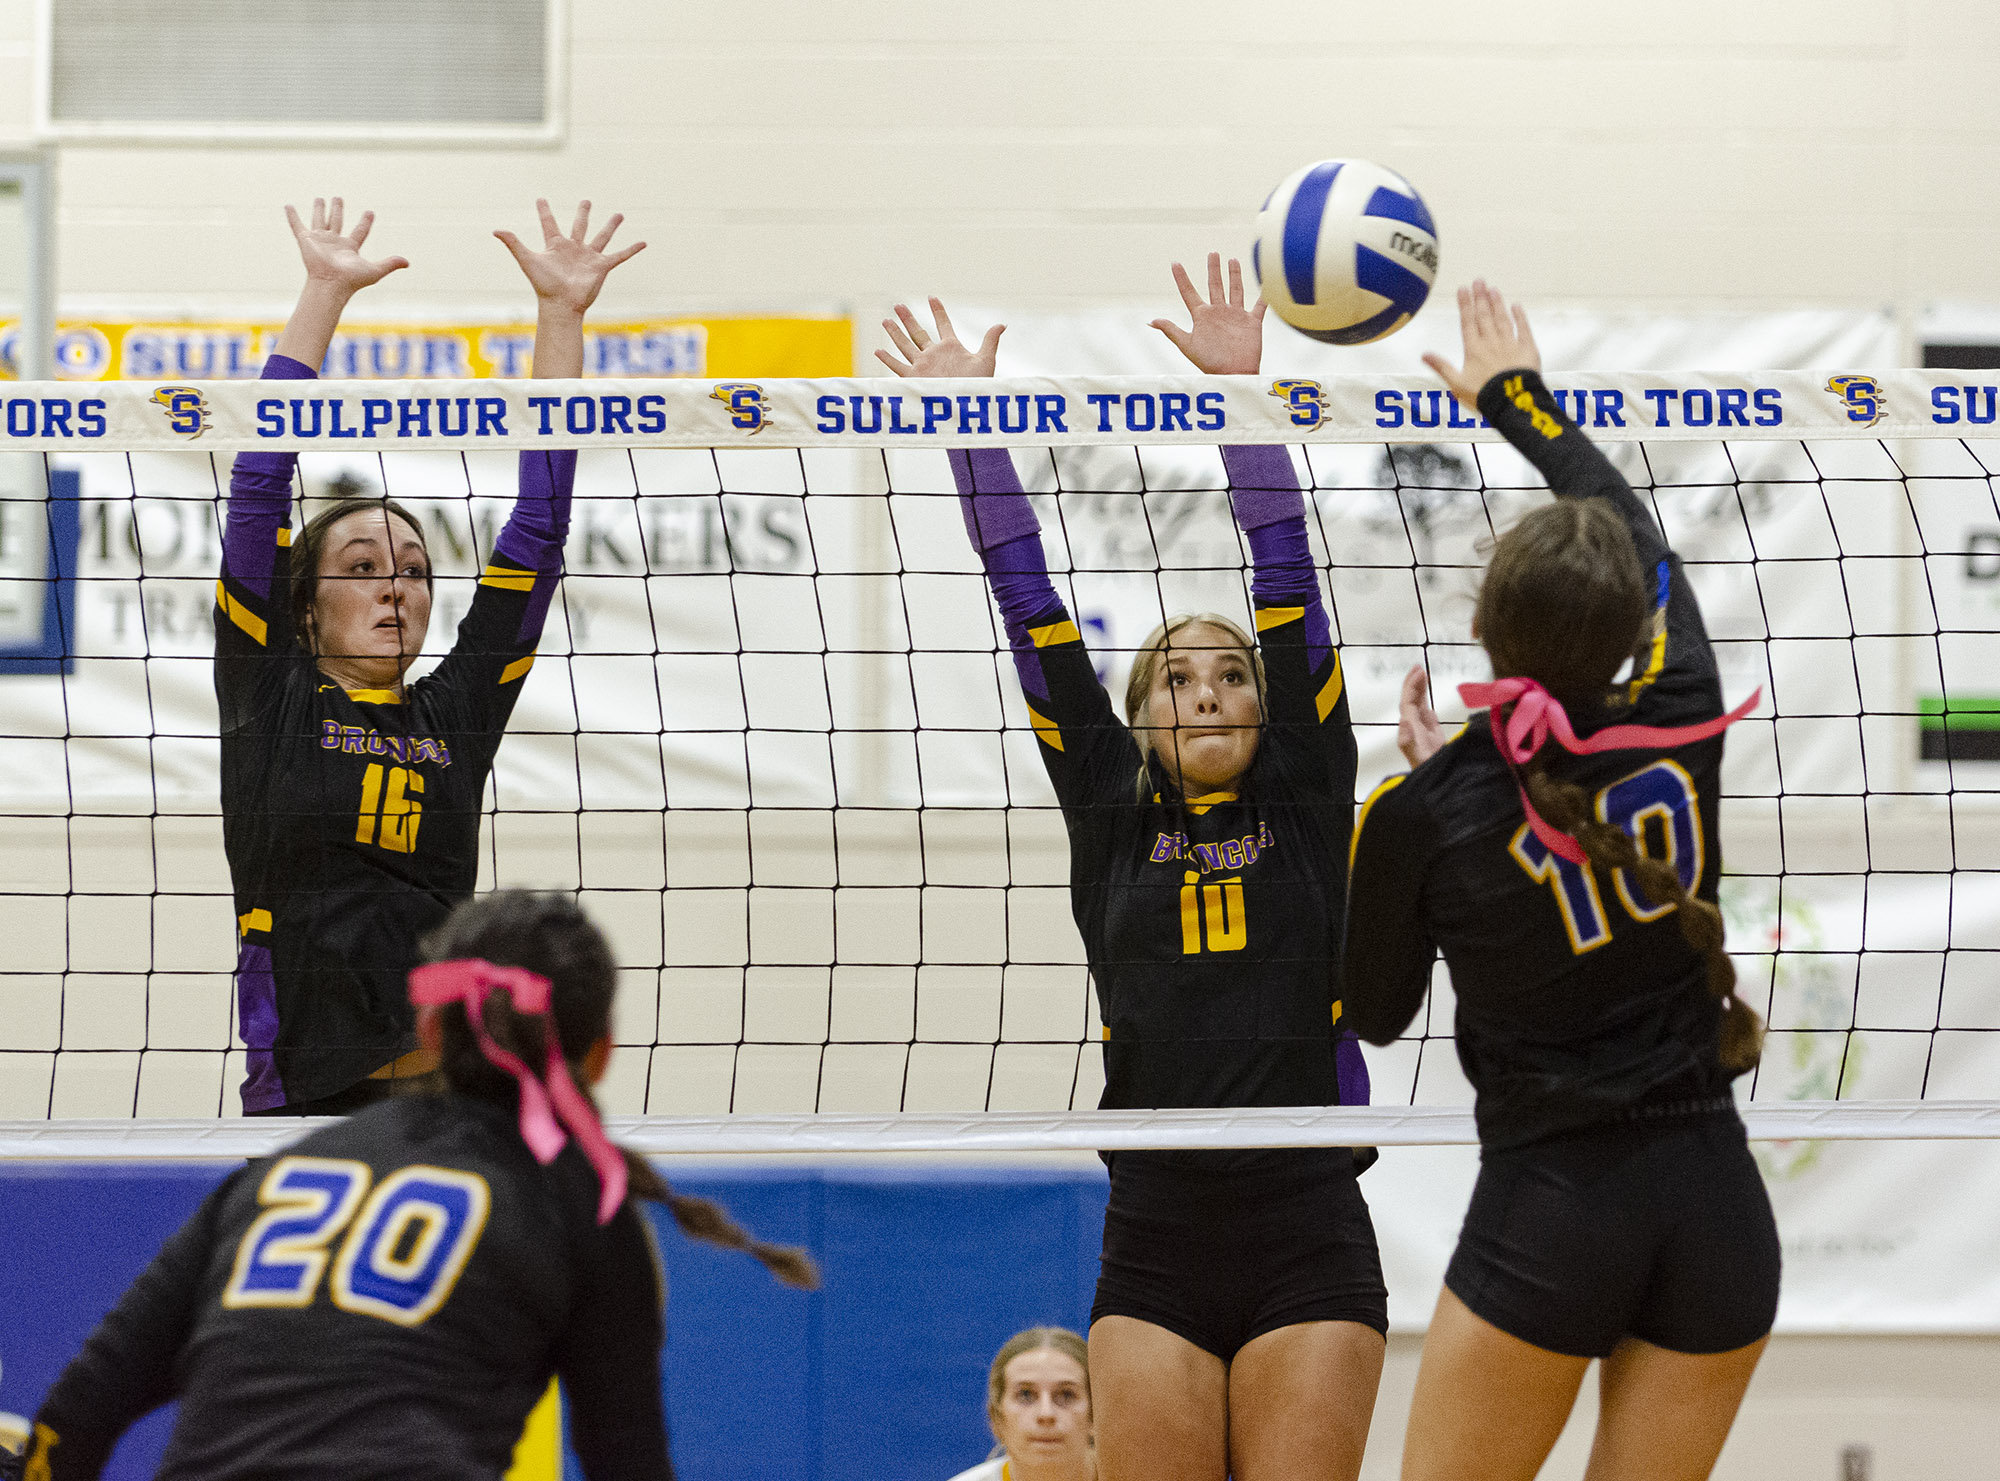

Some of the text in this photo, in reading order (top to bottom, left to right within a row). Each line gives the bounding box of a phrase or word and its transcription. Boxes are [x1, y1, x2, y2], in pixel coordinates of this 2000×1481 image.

[126, 333, 464, 378] SULHUR
[484, 330, 701, 377] TRS!
[0, 398, 106, 438] ORS
[257, 395, 666, 438] SULPHUR TORS
[817, 392, 1225, 434] SULPHUR TORS
[1375, 389, 1626, 429] SULUR
[1644, 388, 1783, 427] TORS
[355, 762, 425, 854] 16
[1149, 821, 1275, 875] BRNCO
[1180, 869, 1248, 955] 10
[221, 1154, 493, 1329] 20
